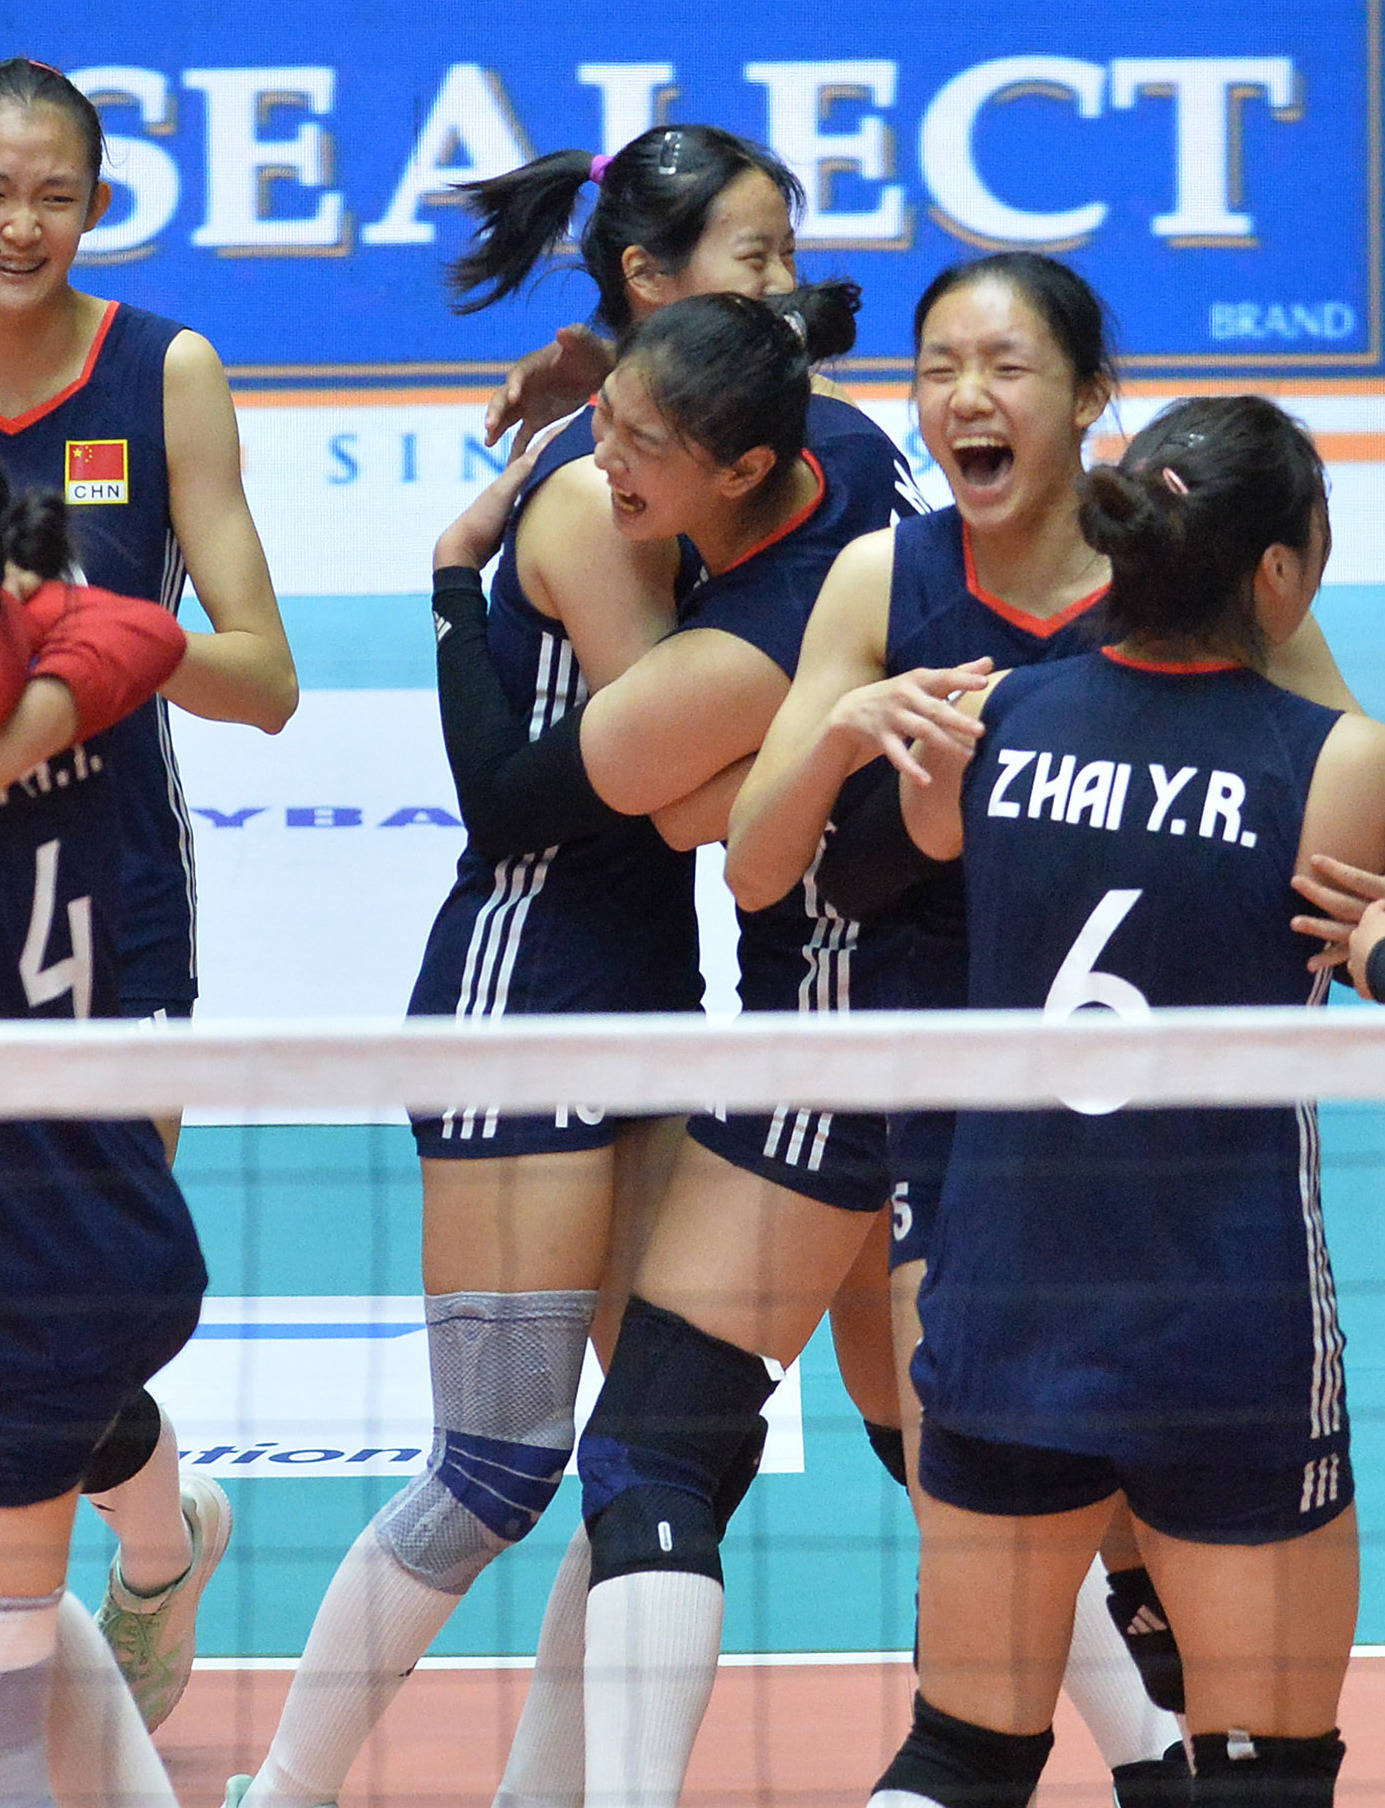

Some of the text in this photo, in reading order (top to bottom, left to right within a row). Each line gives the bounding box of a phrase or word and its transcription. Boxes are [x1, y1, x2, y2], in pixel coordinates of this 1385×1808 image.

[1210, 302, 1355, 339] BRAND
[74, 485, 120, 499] CHN
[987, 749, 1257, 848] ZHAI Y.R.
[19, 838, 93, 1022] 4
[1042, 888, 1154, 1116] 6
